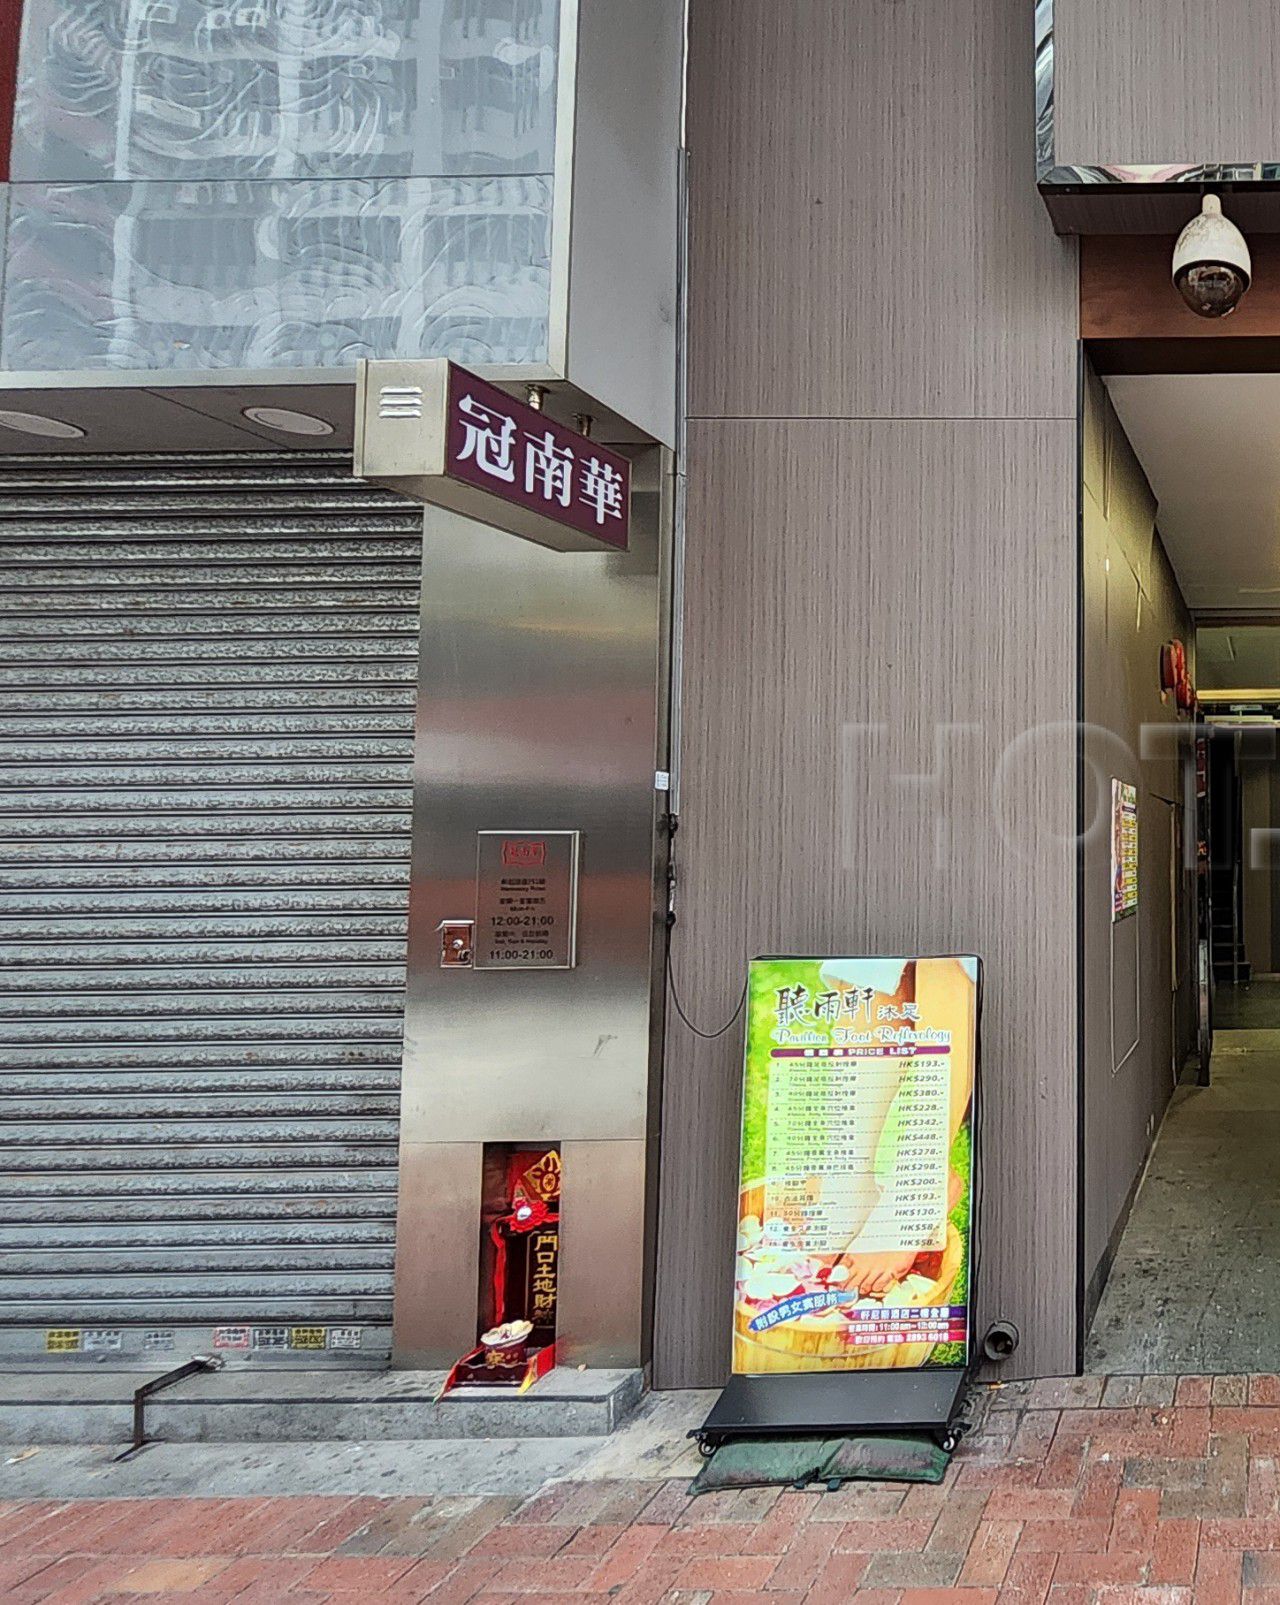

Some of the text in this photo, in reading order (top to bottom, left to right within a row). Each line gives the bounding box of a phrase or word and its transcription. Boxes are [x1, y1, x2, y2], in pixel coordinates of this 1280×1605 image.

[456, 394, 623, 524] 冠南華
[491, 916, 554, 925] 12:00-21:00
[490, 950, 553, 959] 11:00-21:00
[774, 984, 874, 1026] 聽雨軒
[848, 1047, 884, 1056] PRICE
[889, 1046, 917, 1055] LIST
